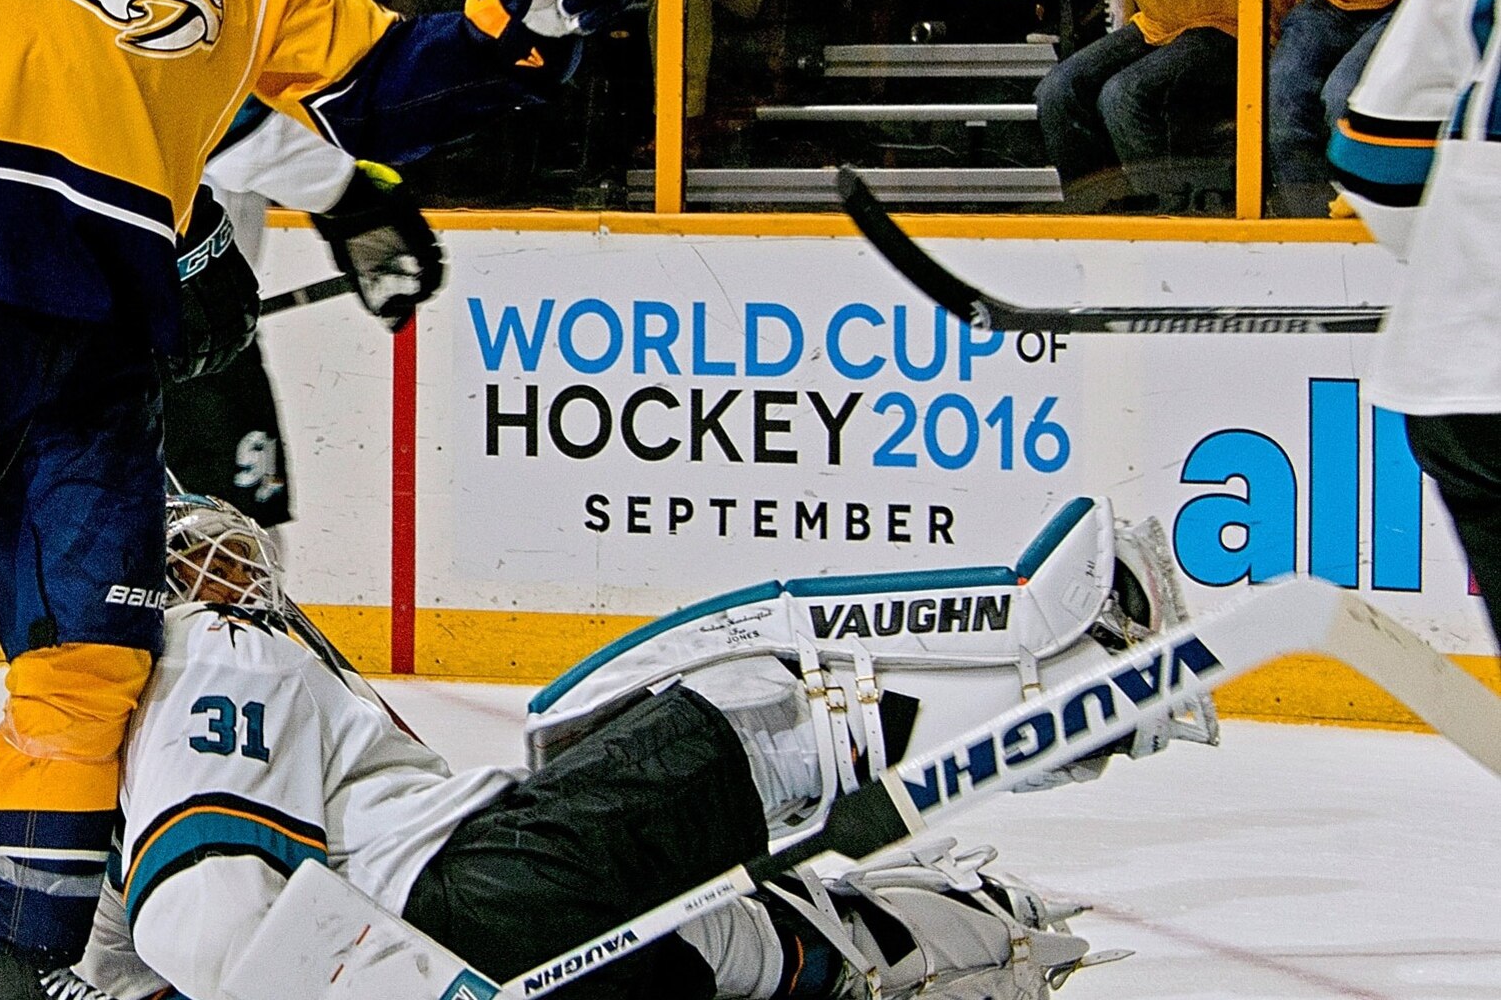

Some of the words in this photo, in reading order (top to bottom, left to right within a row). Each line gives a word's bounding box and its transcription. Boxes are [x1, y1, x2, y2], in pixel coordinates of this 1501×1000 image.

[467, 297, 805, 378] WORLD
[825, 302, 1006, 382] CUP
[1015, 329, 1071, 364] OF
[485, 383, 865, 467] HOCKEY
[871, 391, 1071, 474] 2016
[583, 493, 956, 545] SEPTEMBER
[1172, 376, 1423, 594] all
[809, 594, 1012, 640] VAUGHN
[189, 695, 270, 764] 31
[904, 632, 1226, 814] VAUGHN
[523, 928, 640, 995] VAUGHN
